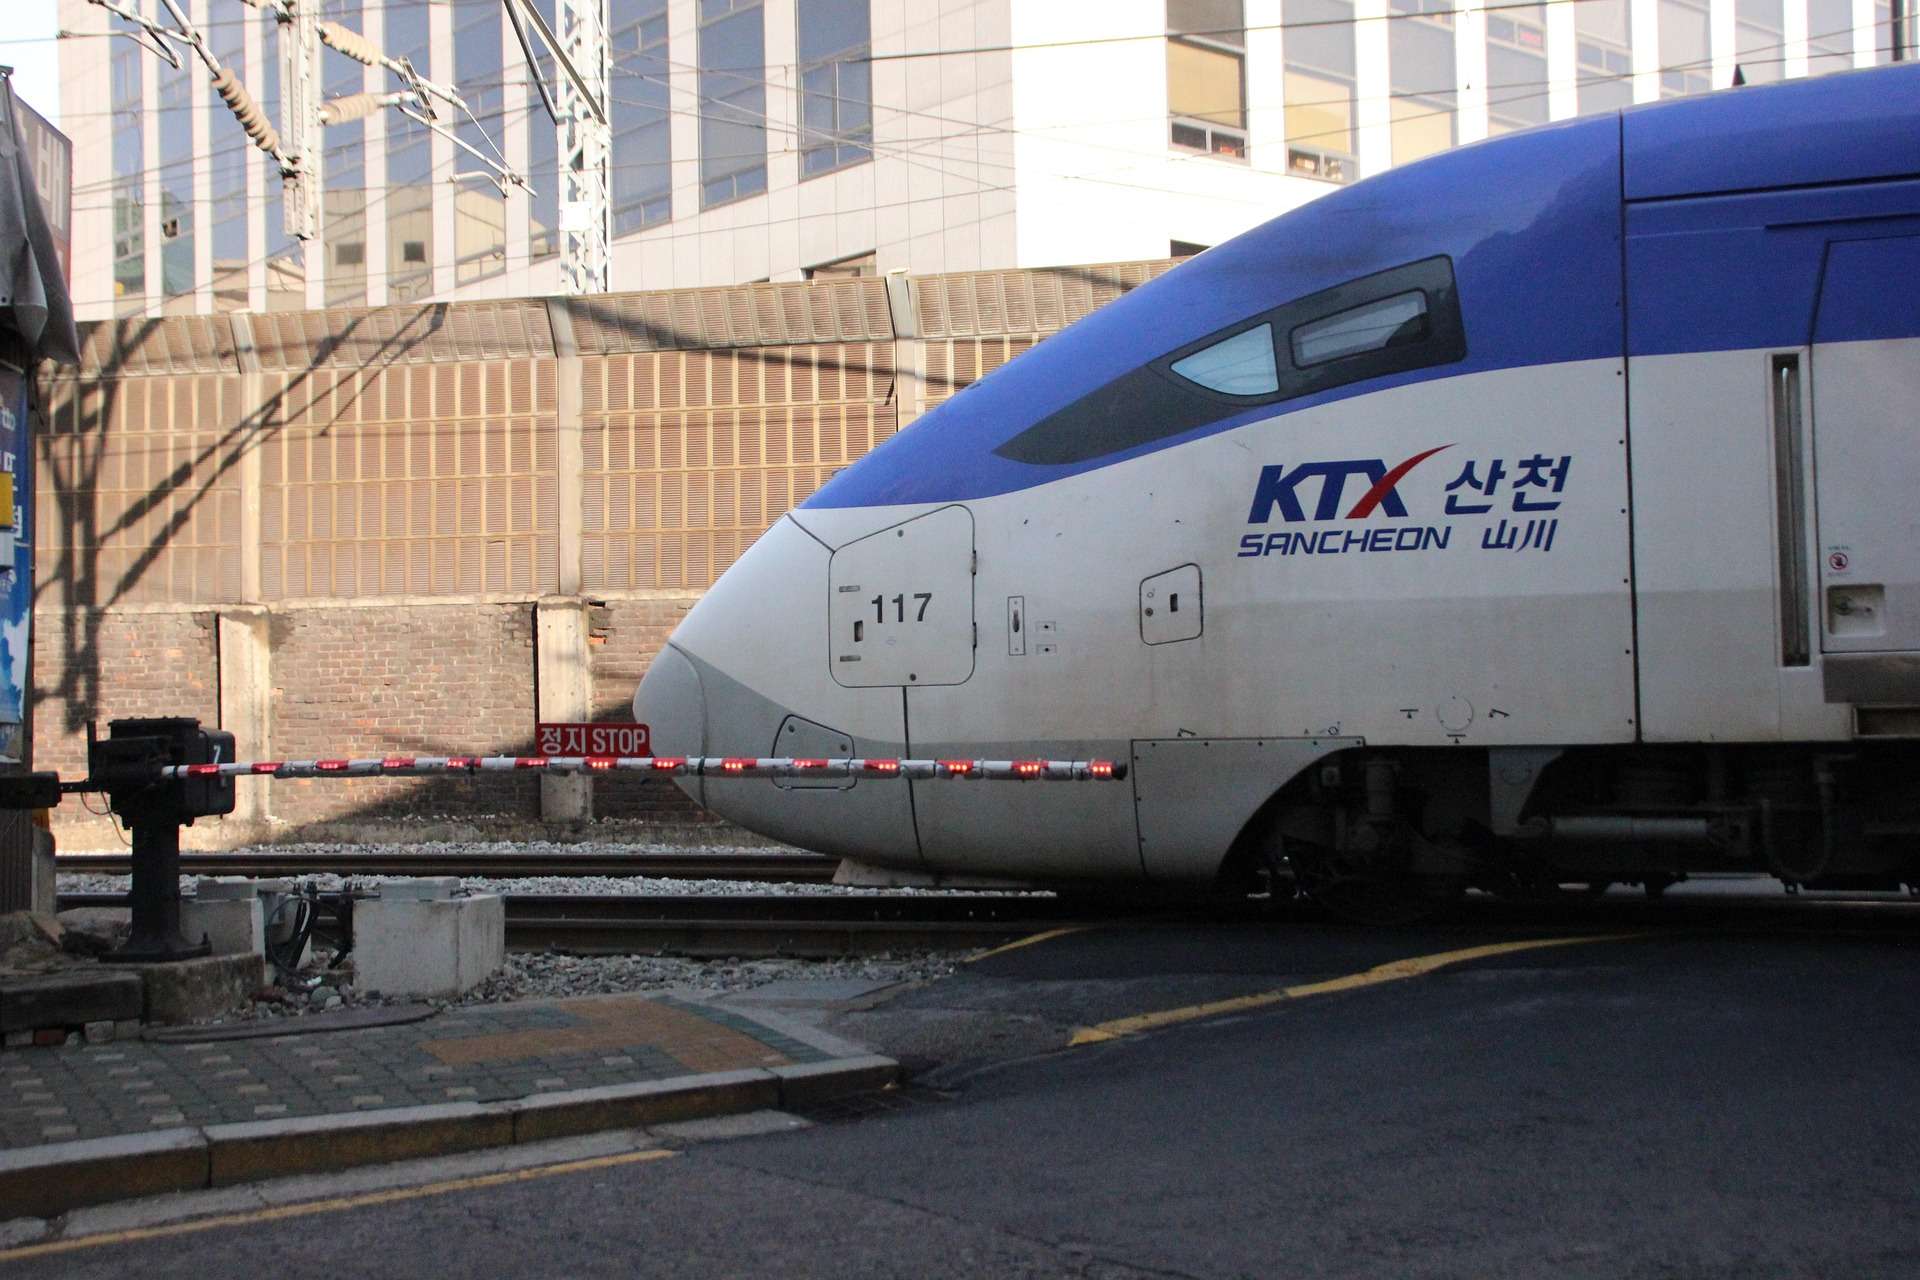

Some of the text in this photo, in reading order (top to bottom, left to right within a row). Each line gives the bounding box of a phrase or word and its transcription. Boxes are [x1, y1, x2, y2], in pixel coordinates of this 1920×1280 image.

[1247, 442, 1572, 524] KTX 산천
[1237, 519, 1559, 558] SANCHEON 山川
[871, 592, 932, 624] 117
[540, 727, 646, 754] 정지 STOP
